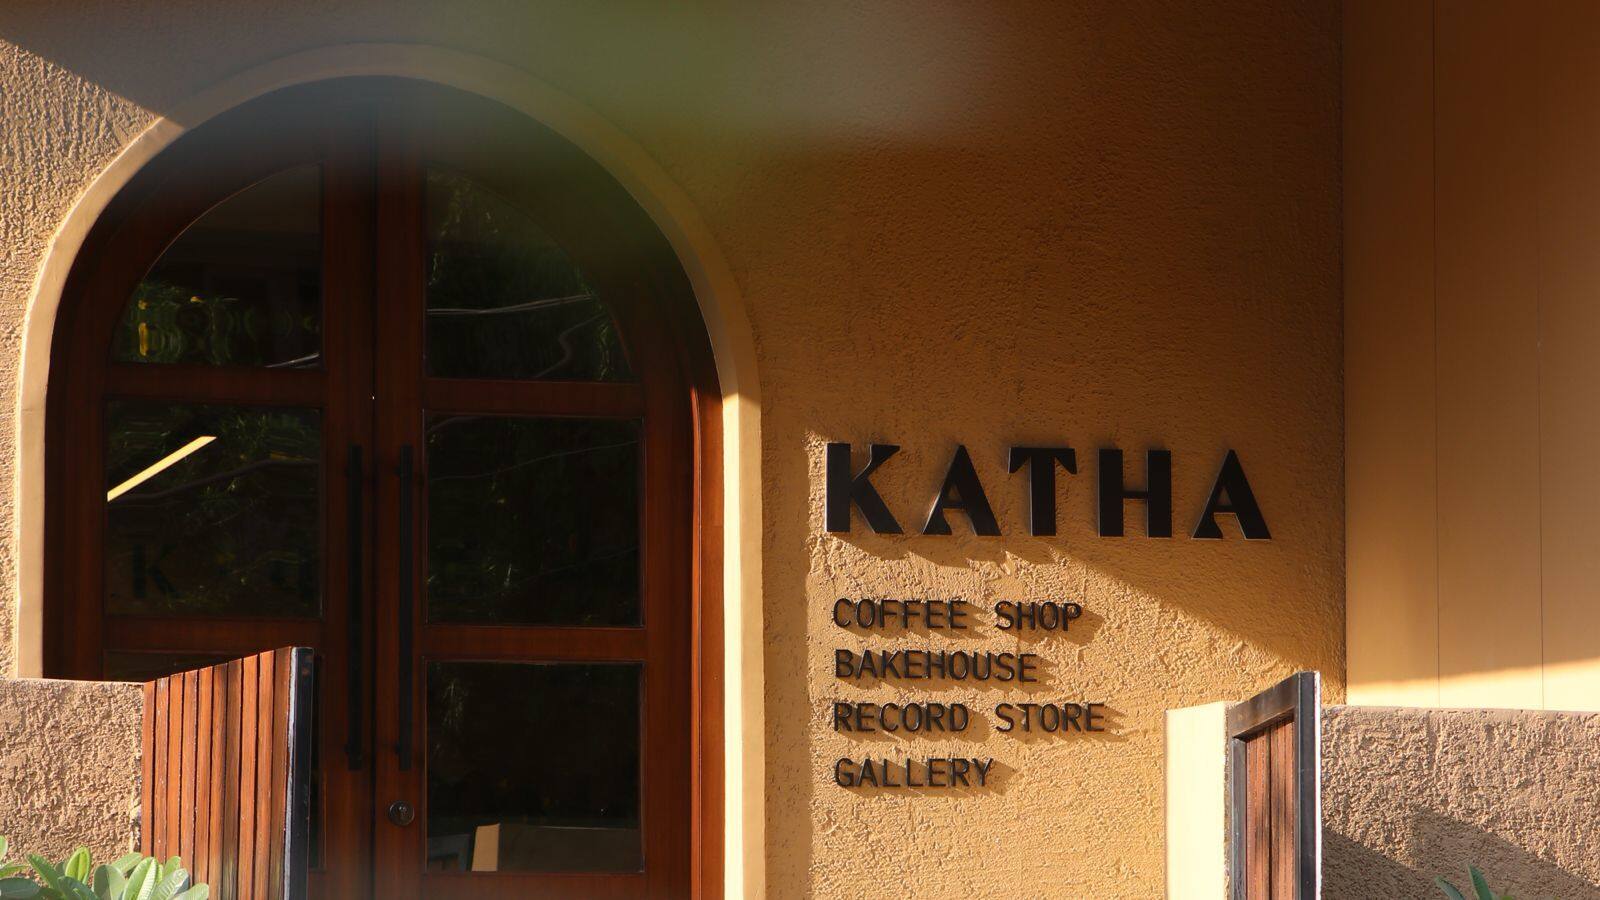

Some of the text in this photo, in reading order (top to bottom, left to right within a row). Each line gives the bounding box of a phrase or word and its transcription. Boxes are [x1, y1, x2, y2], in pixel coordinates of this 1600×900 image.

[825, 441, 1272, 540] KATHA
[832, 598, 1082, 632] COFFEE SHOP
[835, 649, 1038, 683] BAKEHOUSE
[834, 702, 1106, 734] RECORD STORE
[834, 757, 993, 789] GALLERY
